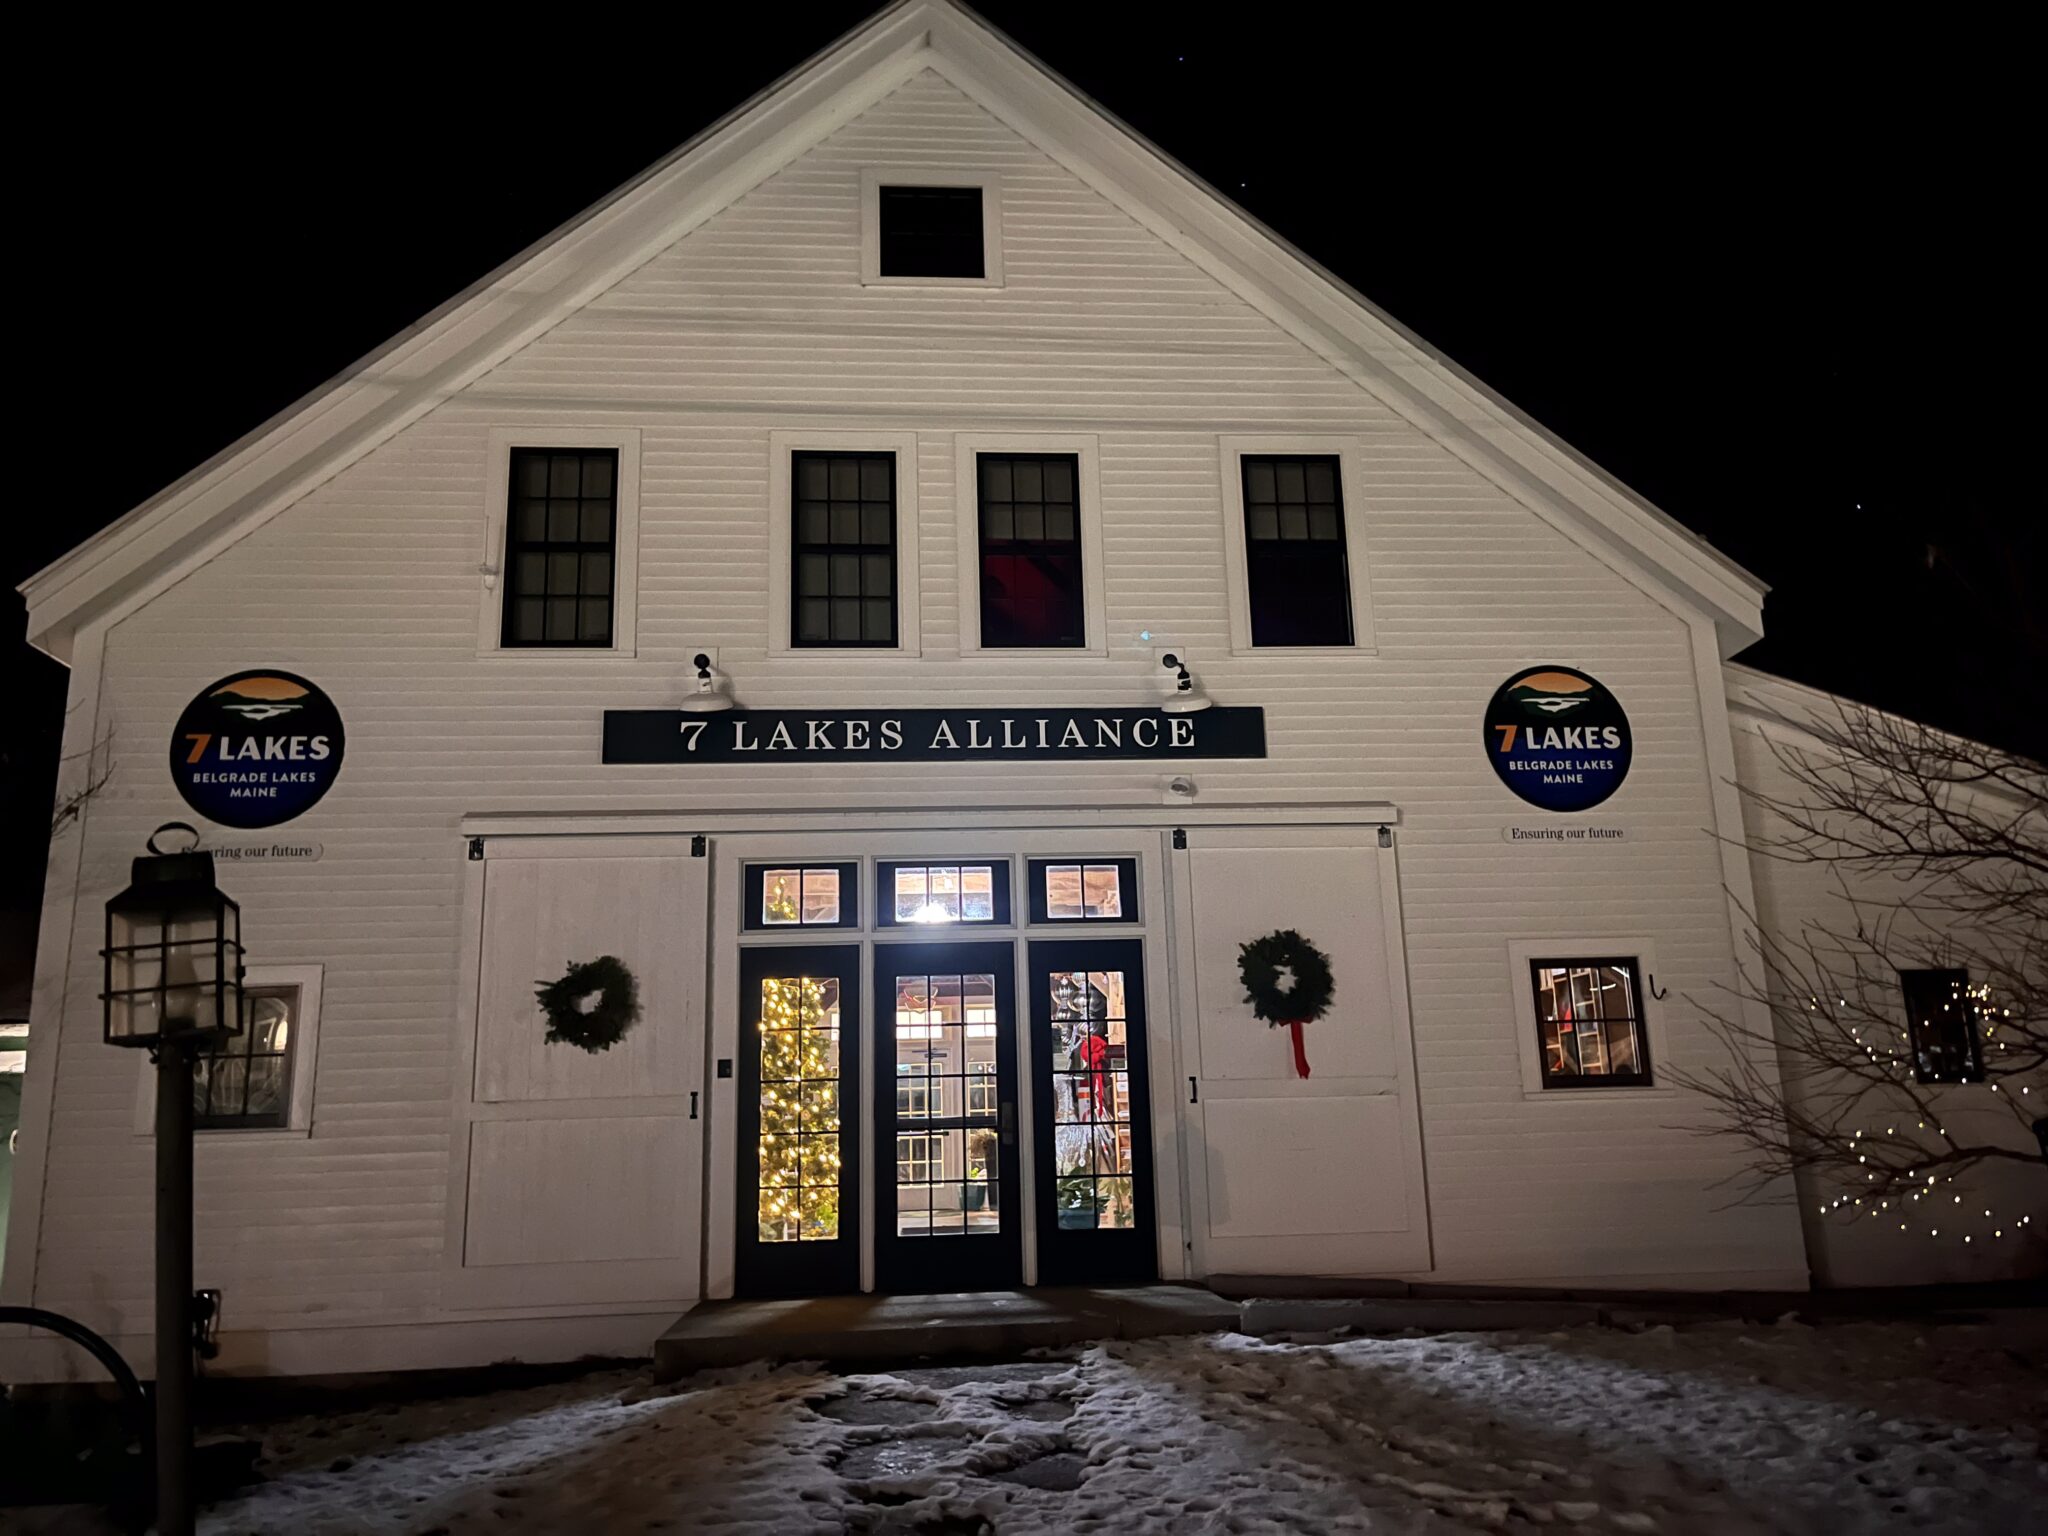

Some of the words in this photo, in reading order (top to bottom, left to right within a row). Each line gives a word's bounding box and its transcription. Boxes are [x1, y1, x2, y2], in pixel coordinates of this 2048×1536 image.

[679, 721, 708, 751] 7
[732, 720, 903, 750] LAKES
[929, 718, 1195, 748] ALLIANCE
[1495, 725, 1518, 752] 7
[1526, 726, 1621, 749] LAKES
[186, 734, 212, 763] 7
[219, 735, 330, 761] LAKES
[1509, 761, 1572, 770] BELGRADE
[1576, 760, 1613, 769] LAKES
[193, 773, 267, 783] BELGRADE
[272, 772, 316, 782] LAKES
[1543, 775, 1583, 783] MAINE
[230, 787, 277, 797] MAINE
[1512, 828, 1564, 841] Ensuring
[1566, 830, 1585, 839] our
[1588, 828, 1624, 838] future
[244, 848, 268, 857] our
[271, 845, 312, 856] future
